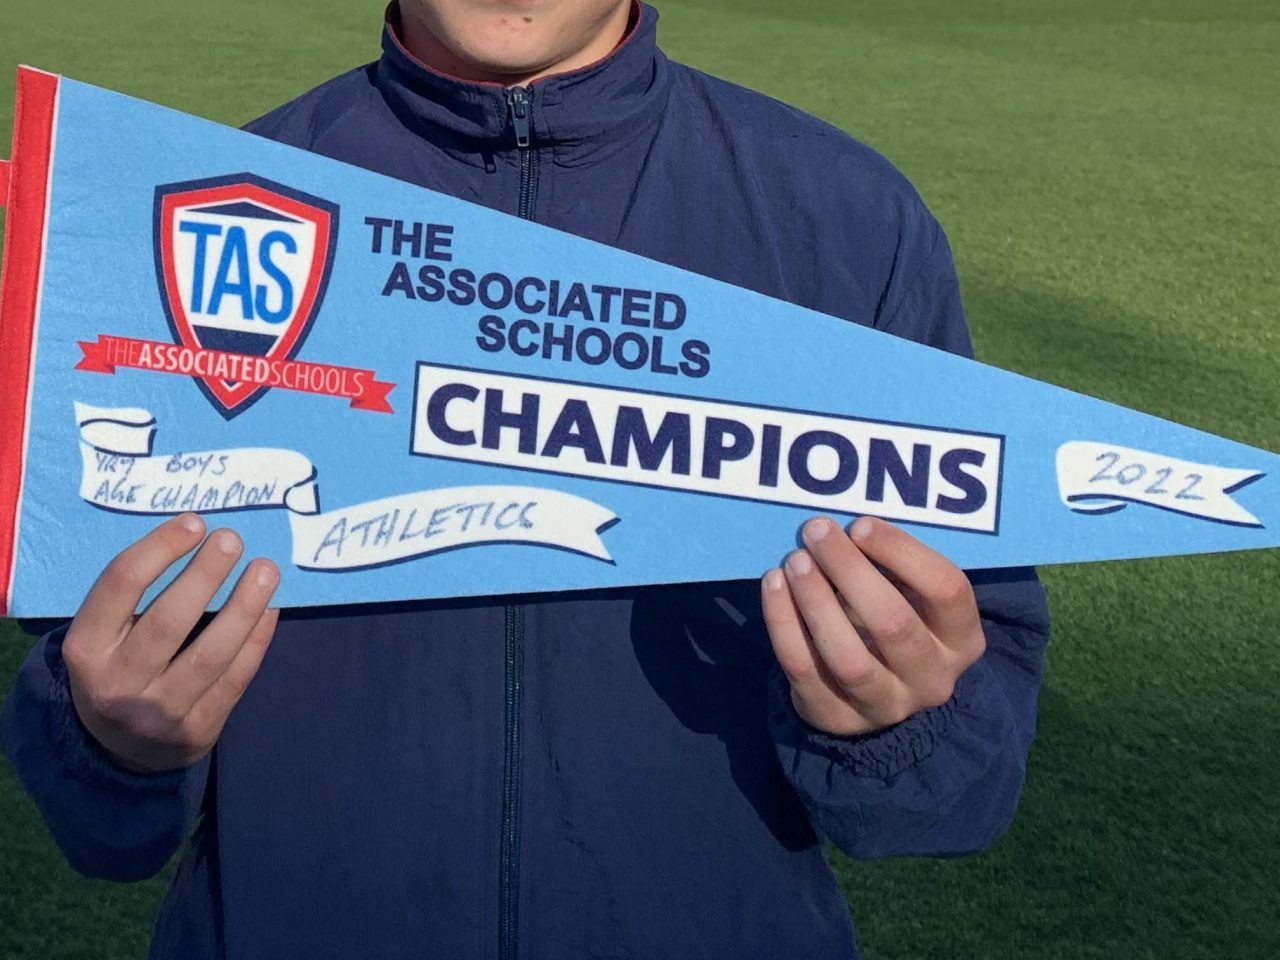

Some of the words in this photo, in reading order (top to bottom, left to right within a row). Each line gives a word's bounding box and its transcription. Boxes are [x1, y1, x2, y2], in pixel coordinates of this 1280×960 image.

[364, 216, 454, 261] THE
[179, 220, 298, 324] TAS
[381, 261, 687, 331] ASSOCIATED
[476, 314, 711, 378] SCHOOLS
[165, 452, 228, 477] BOYS
[426, 383, 988, 514] CHAMPIONS
[1088, 451, 1207, 500] 2022
[93, 477, 142, 504] AGE
[150, 478, 279, 510] CHAMPION
[312, 501, 538, 563] ATHLETICS
